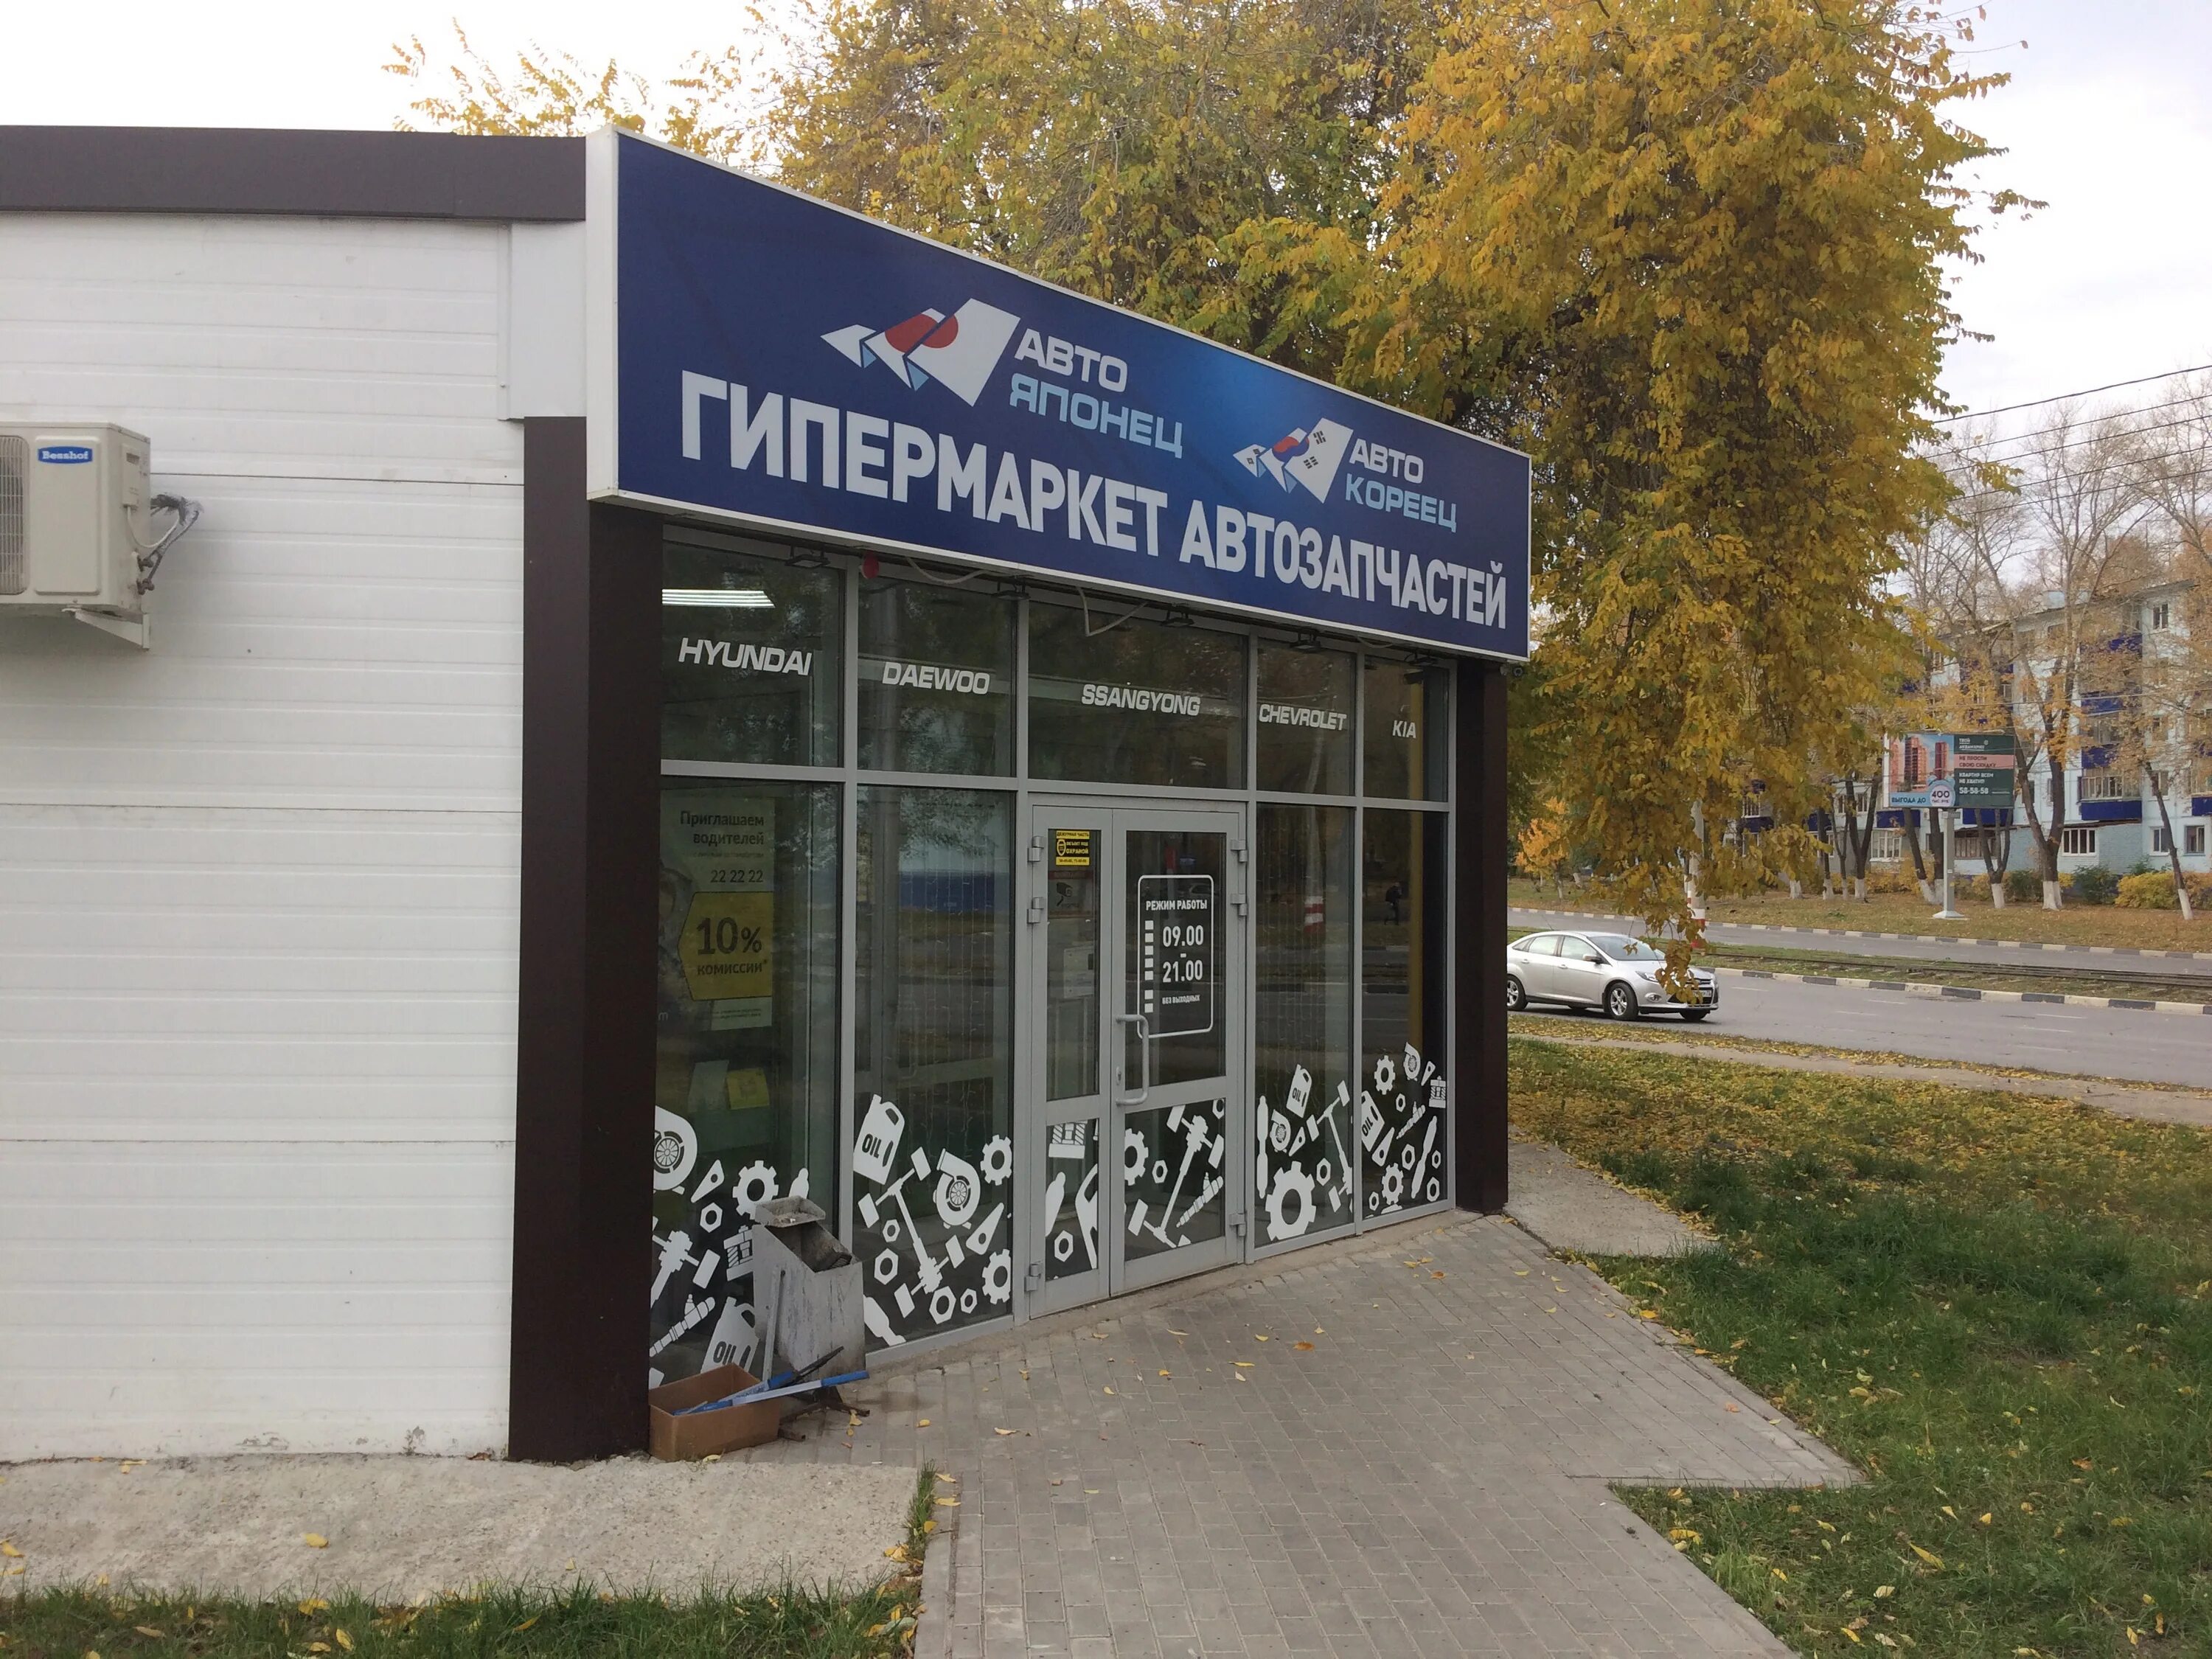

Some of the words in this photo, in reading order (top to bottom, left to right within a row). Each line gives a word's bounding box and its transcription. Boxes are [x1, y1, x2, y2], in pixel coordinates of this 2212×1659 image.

[1015, 329, 1128, 393] АВТО
[1009, 374, 1183, 459] ЯПОНЕЦ
[42, 451, 88, 460] Besshof
[1349, 438, 1424, 484] АВТО
[681, 369, 1168, 557] ГИПЕРМАРКЕТ
[1179, 500, 1507, 630] АВТОЗАПЧАСТЕЙ
[1345, 473, 1457, 533] КОРЕЕЦ
[678, 638, 812, 675] HYUNDAI
[882, 661, 990, 695] DAEWOO
[1081, 684, 1201, 716] SSANGYONG
[1259, 704, 1347, 731] CHEVROLET
[1392, 720, 1416, 739] KIA
[1932, 790, 1950, 799] 400
[681, 811, 764, 827] Приглашаем
[694, 832, 764, 845] водителей
[710, 870, 726, 883] 22
[730, 870, 745, 883] 22
[748, 870, 763, 883] 22
[1146, 901, 1175, 911] РЕЖИМ
[1177, 900, 1207, 910] РАБОТЫ
[697, 917, 762, 955] 10%
[1163, 925, 1203, 947] 09.00
[1163, 960, 1203, 982] 21.00
[1172, 995, 1200, 1004] ВЫХОДНЫХ
[1292, 1087, 1301, 1102] OIL
[1361, 1116, 1374, 1137] OIL
[861, 1133, 880, 1159] OIL
